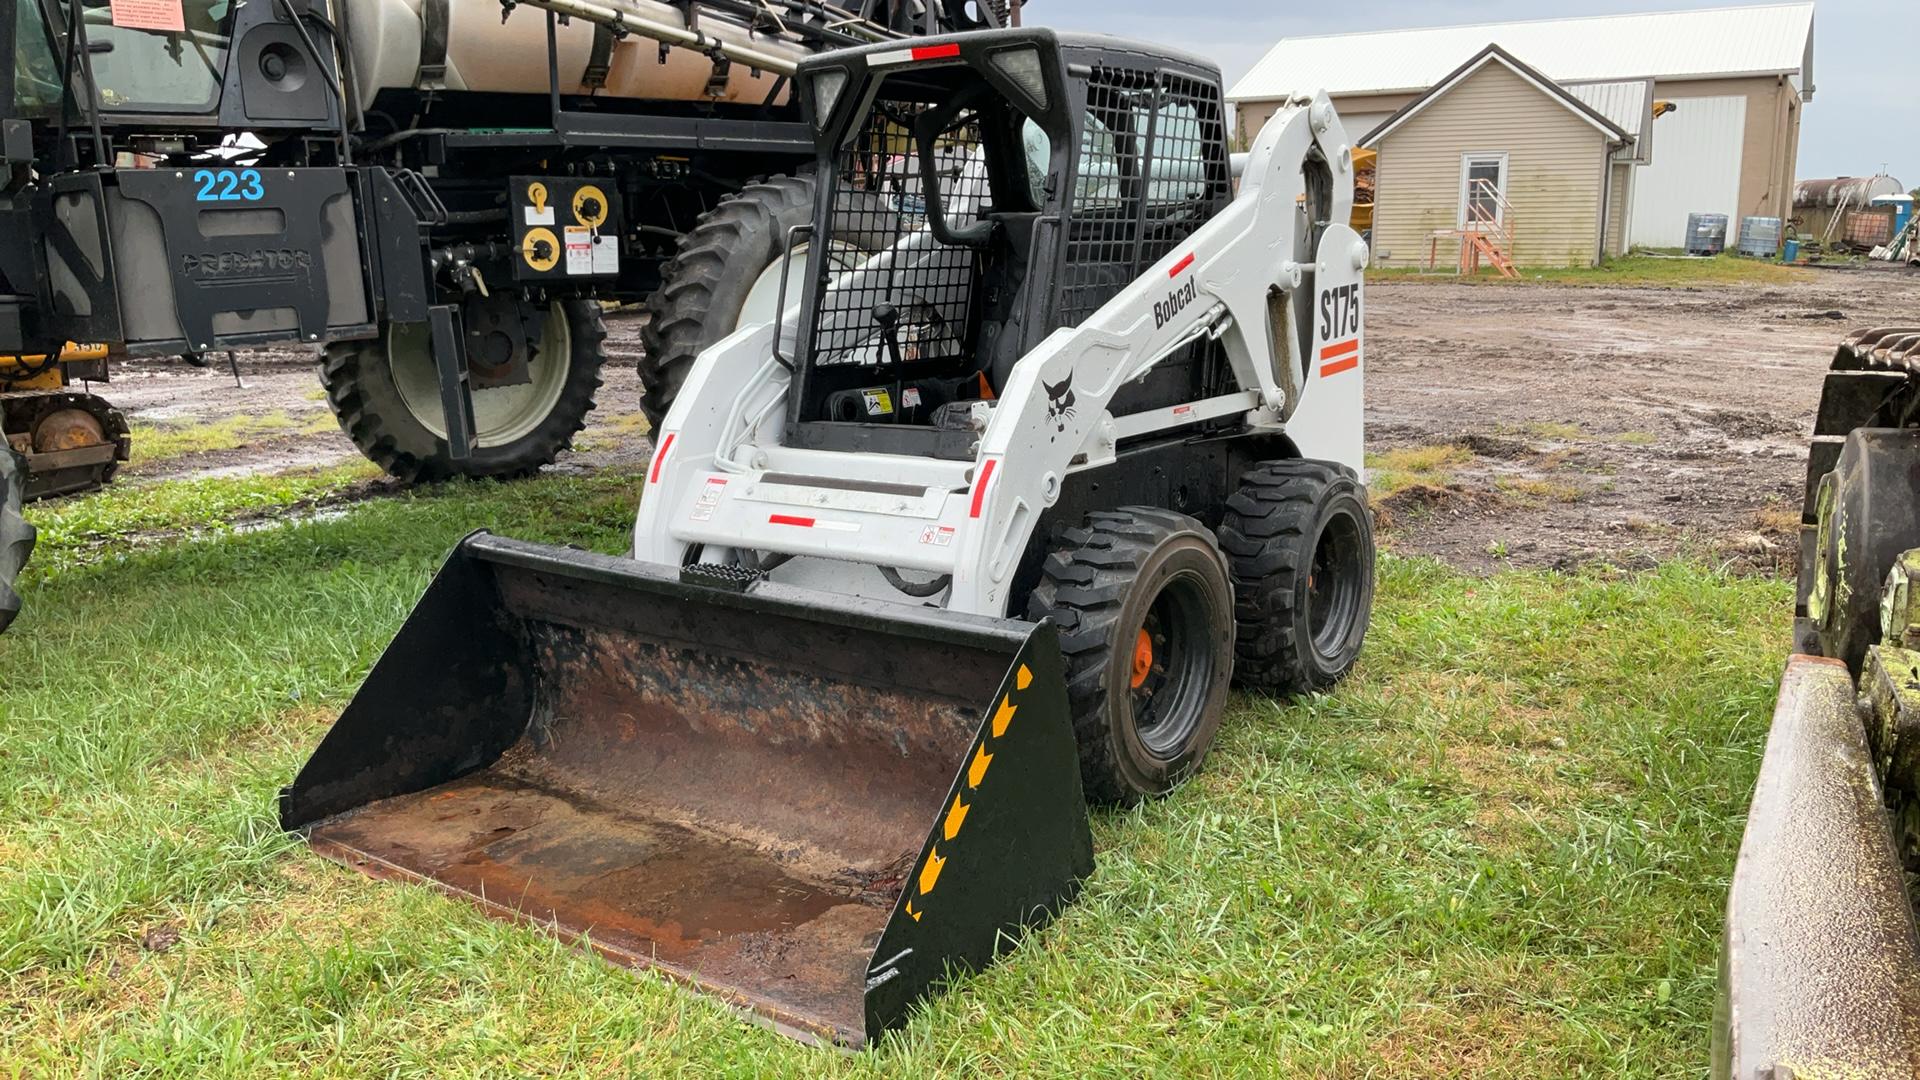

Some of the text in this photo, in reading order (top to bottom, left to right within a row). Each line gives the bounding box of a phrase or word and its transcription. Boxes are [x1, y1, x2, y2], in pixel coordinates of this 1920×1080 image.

[194, 169, 264, 201] 223
[1153, 274, 1196, 330] Bobcat
[1320, 283, 1358, 341] S175
